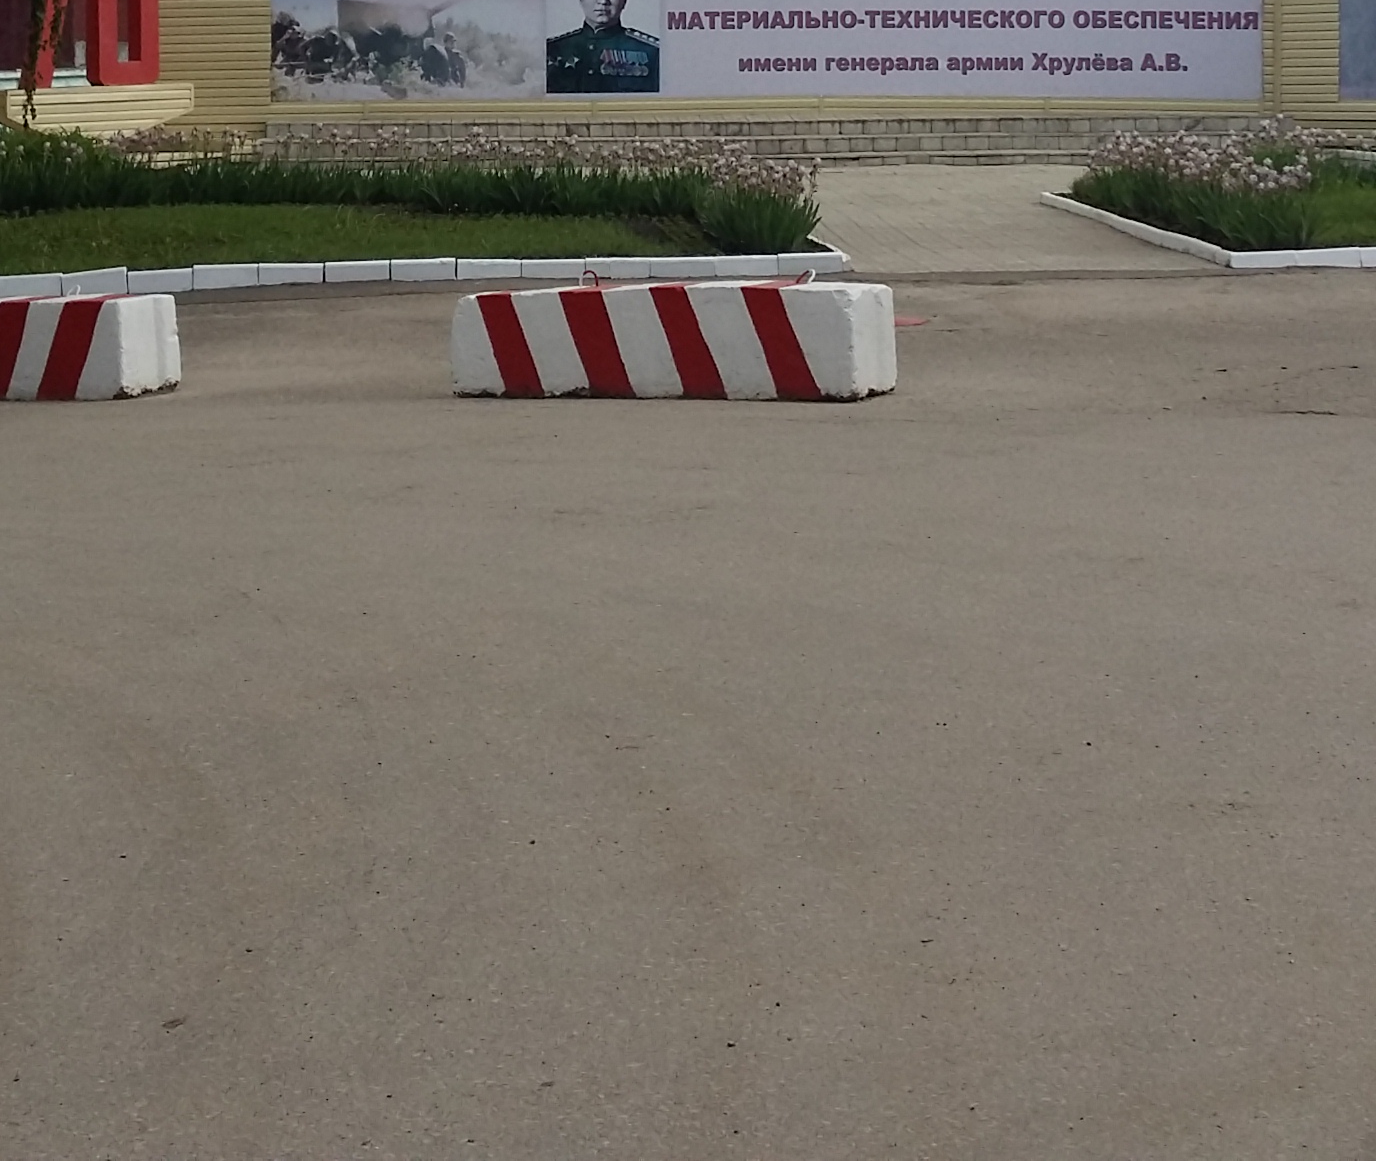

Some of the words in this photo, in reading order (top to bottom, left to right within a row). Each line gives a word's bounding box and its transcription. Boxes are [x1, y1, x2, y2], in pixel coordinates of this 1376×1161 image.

[667, 9, 1066, 31] МАТЕРИАЛЬНО-ТЕХНИЧЕСКОГО
[1072, 9, 1260, 31] ОБЕСПЕЧЕНИЯ
[738, 56, 817, 72] имени
[824, 56, 939, 76] генерала
[946, 56, 1024, 76] армии
[1030, 52, 1134, 76] Хрулёва
[1139, 52, 1189, 72] А.В.
